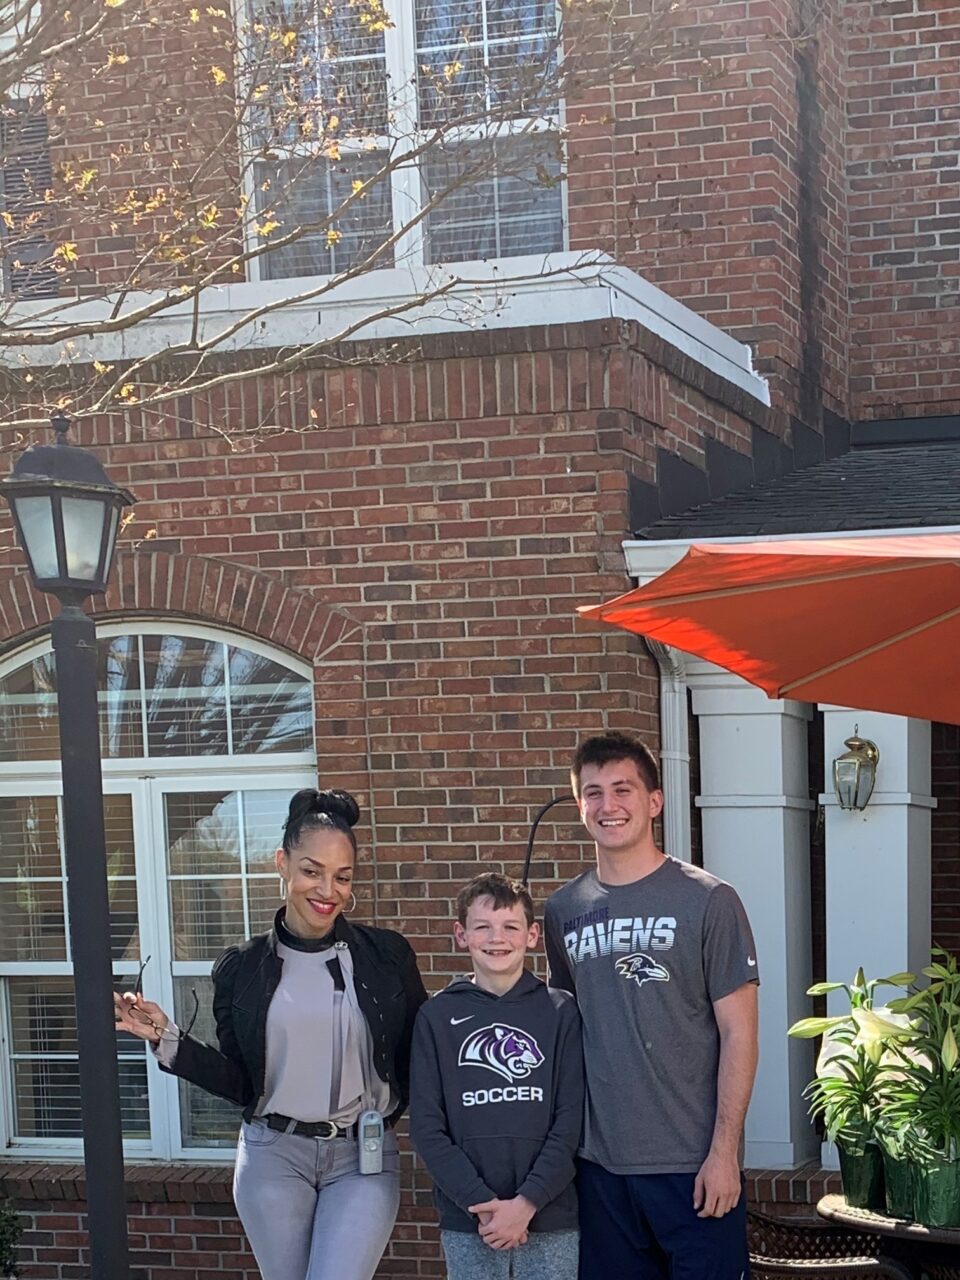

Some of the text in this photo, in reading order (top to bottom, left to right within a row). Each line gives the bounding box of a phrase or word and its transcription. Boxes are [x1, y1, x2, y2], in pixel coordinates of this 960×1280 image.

[564, 907, 609, 932] BALTIMORE
[564, 917, 677, 964] RAVENS
[462, 1086, 543, 1107] SOCCER
